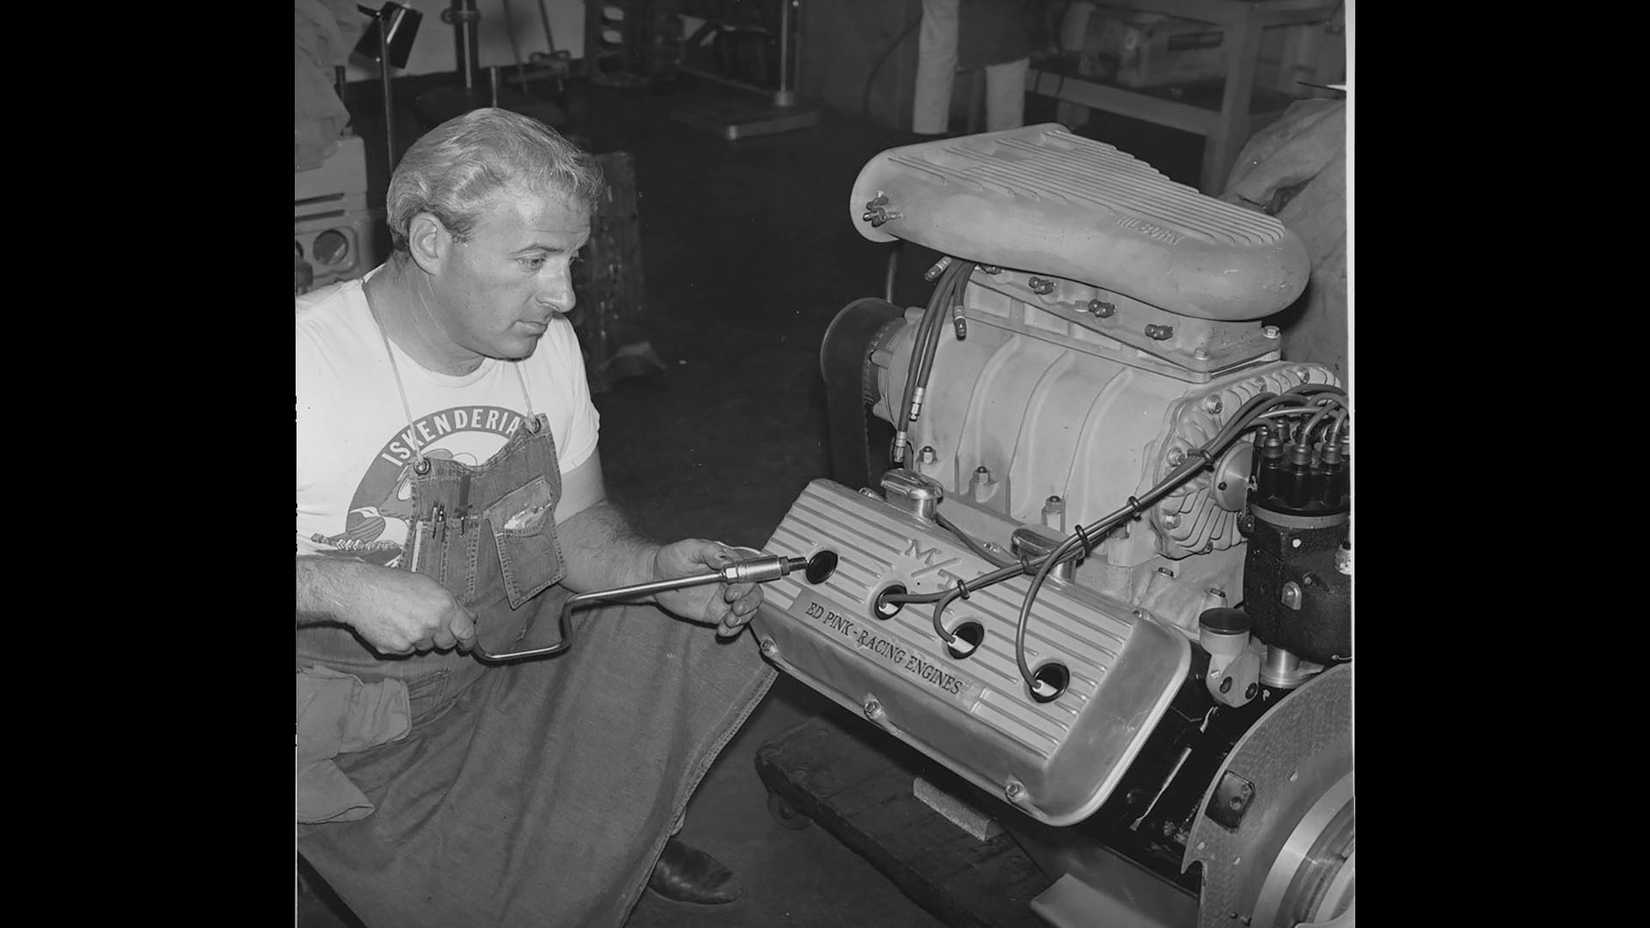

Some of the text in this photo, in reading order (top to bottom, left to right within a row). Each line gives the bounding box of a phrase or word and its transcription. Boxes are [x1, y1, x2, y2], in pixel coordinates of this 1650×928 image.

[805, 601, 825, 620] ED
[823, 611, 854, 637] PINK
[857, 629, 906, 664] RACING
[905, 655, 964, 696] ENGINES
